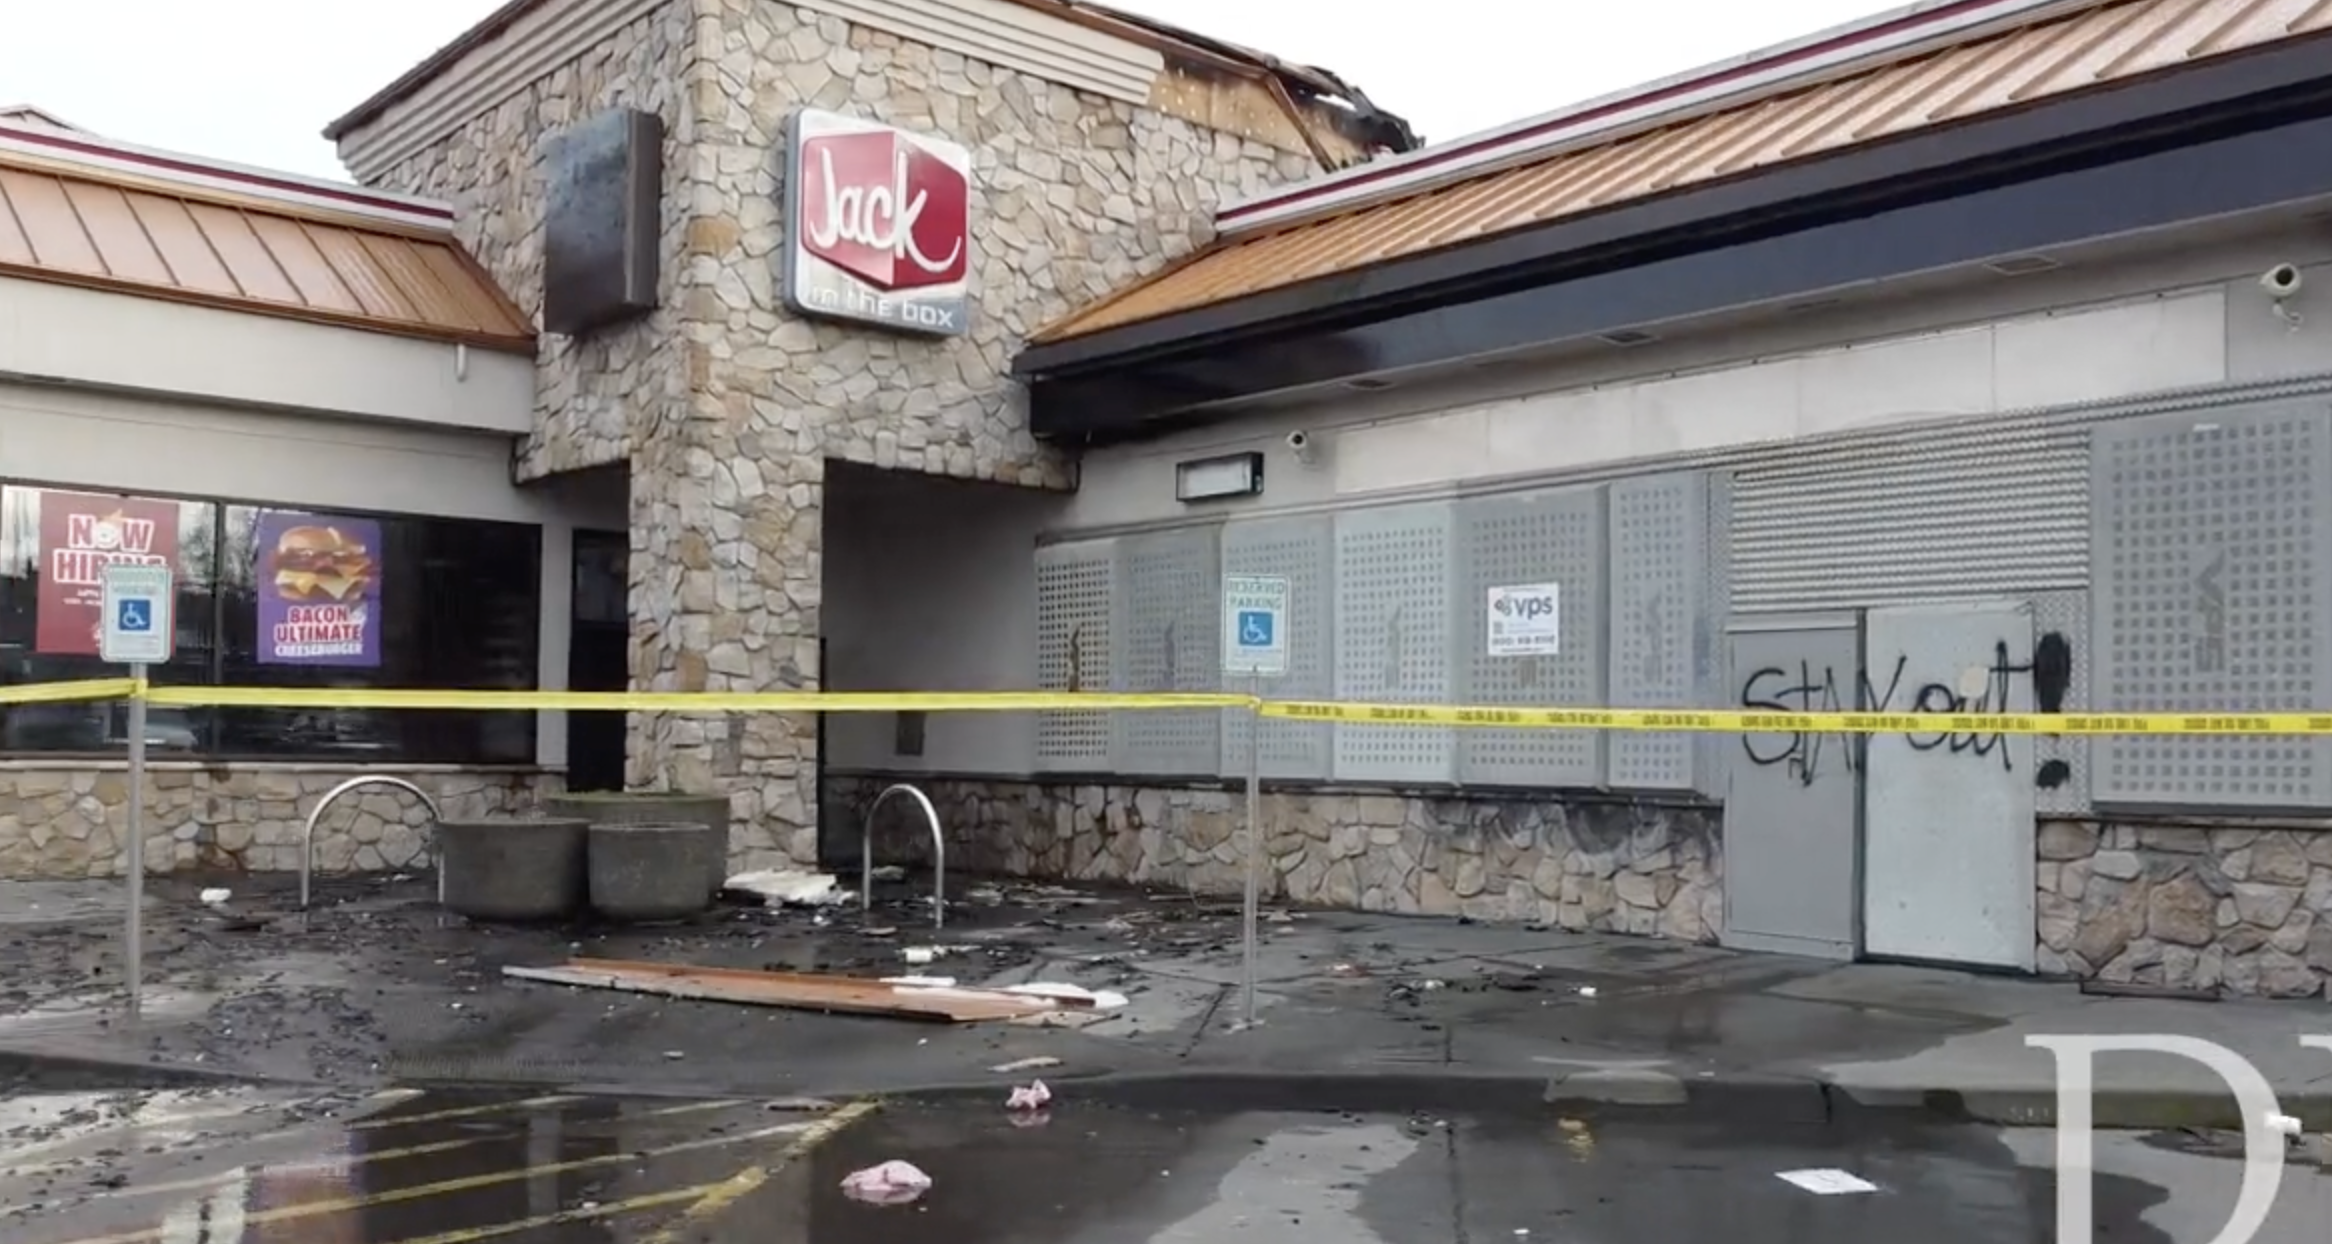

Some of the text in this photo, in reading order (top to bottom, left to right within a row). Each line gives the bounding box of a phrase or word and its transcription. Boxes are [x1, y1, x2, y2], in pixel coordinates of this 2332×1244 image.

[810, 146, 962, 273] Jack
[811, 286, 954, 328] in the box
[68, 514, 155, 553] NOW
[288, 606, 348, 624] BACON
[1229, 596, 1282, 610] PARKING
[1514, 596, 1553, 621] vps
[274, 623, 362, 643] ULTIMATE
